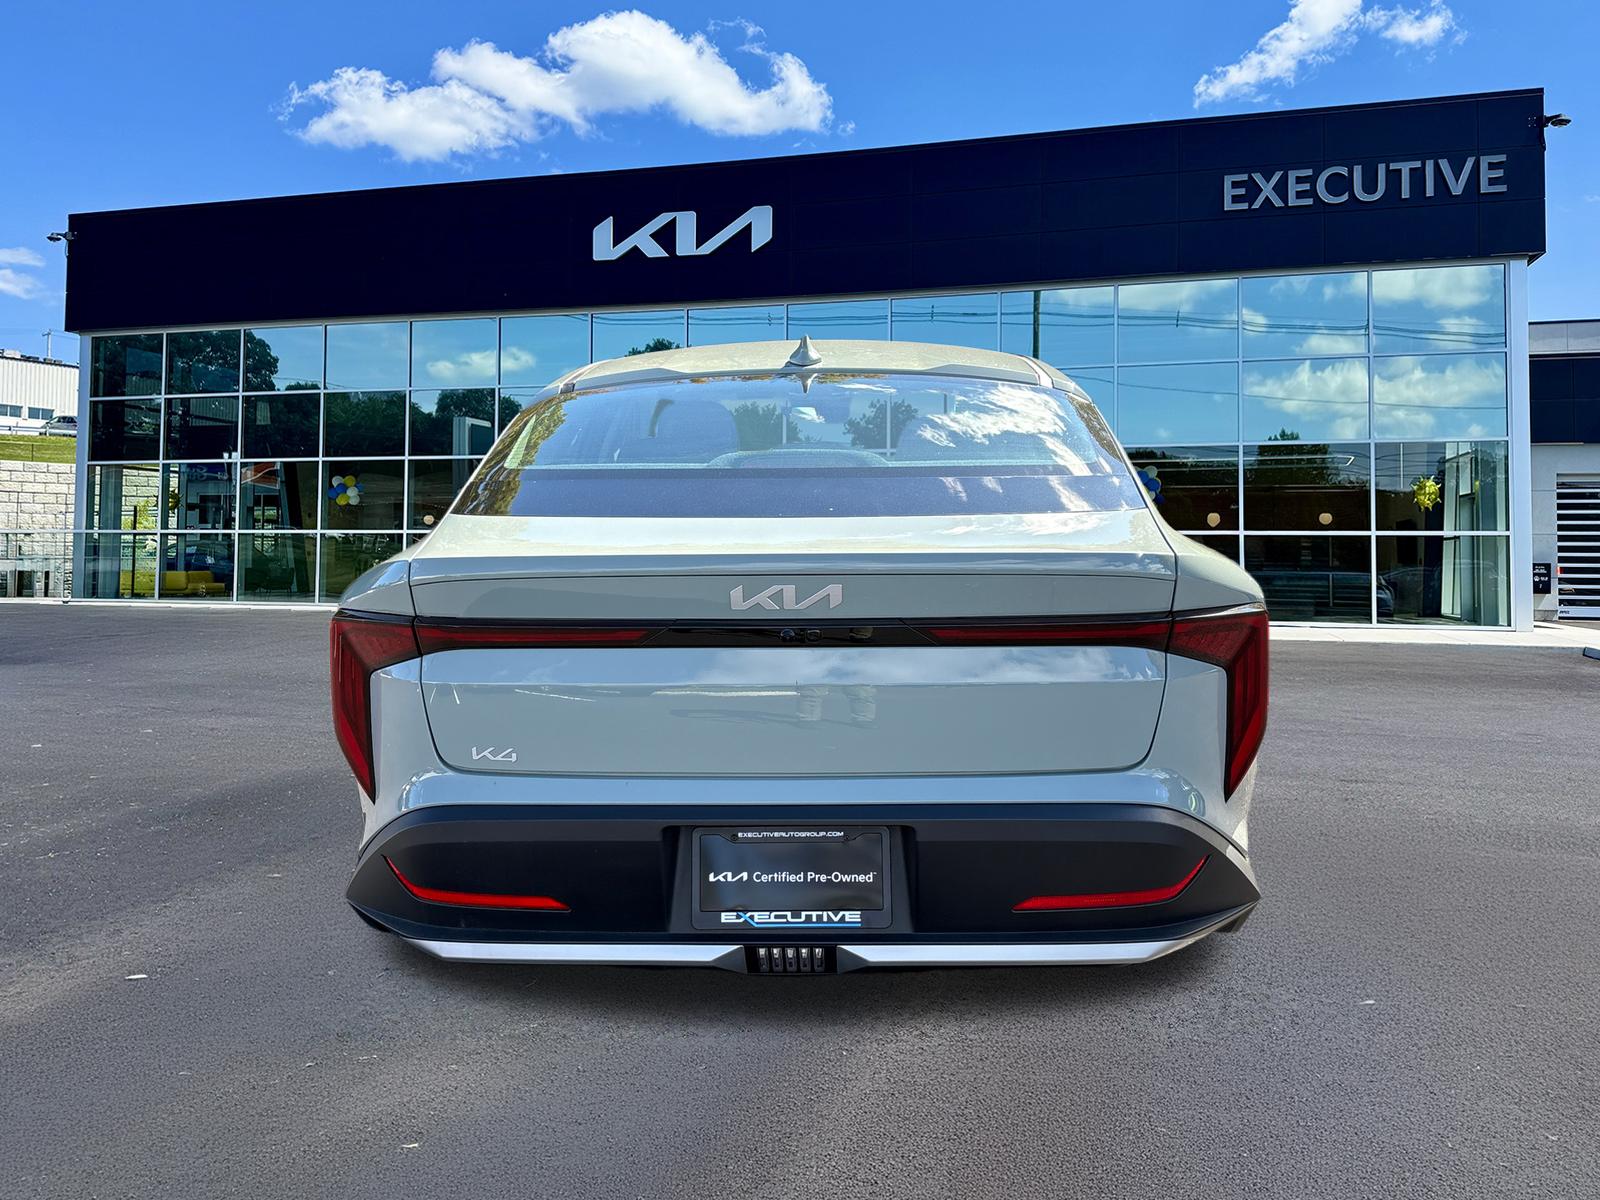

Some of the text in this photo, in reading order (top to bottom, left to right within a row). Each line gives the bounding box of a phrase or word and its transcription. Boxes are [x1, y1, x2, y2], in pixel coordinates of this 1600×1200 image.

[1223, 154, 1508, 211] EXECUTIVE
[593, 205, 773, 261] KIA
[730, 584, 843, 610] KIA
[471, 746, 517, 762] K4
[737, 831, 844, 839] EXECUTIVEAUTOGROUP.COM
[708, 871, 874, 883] KIA Certified Pre-Owned
[720, 911, 862, 926] EXECUTIVE
